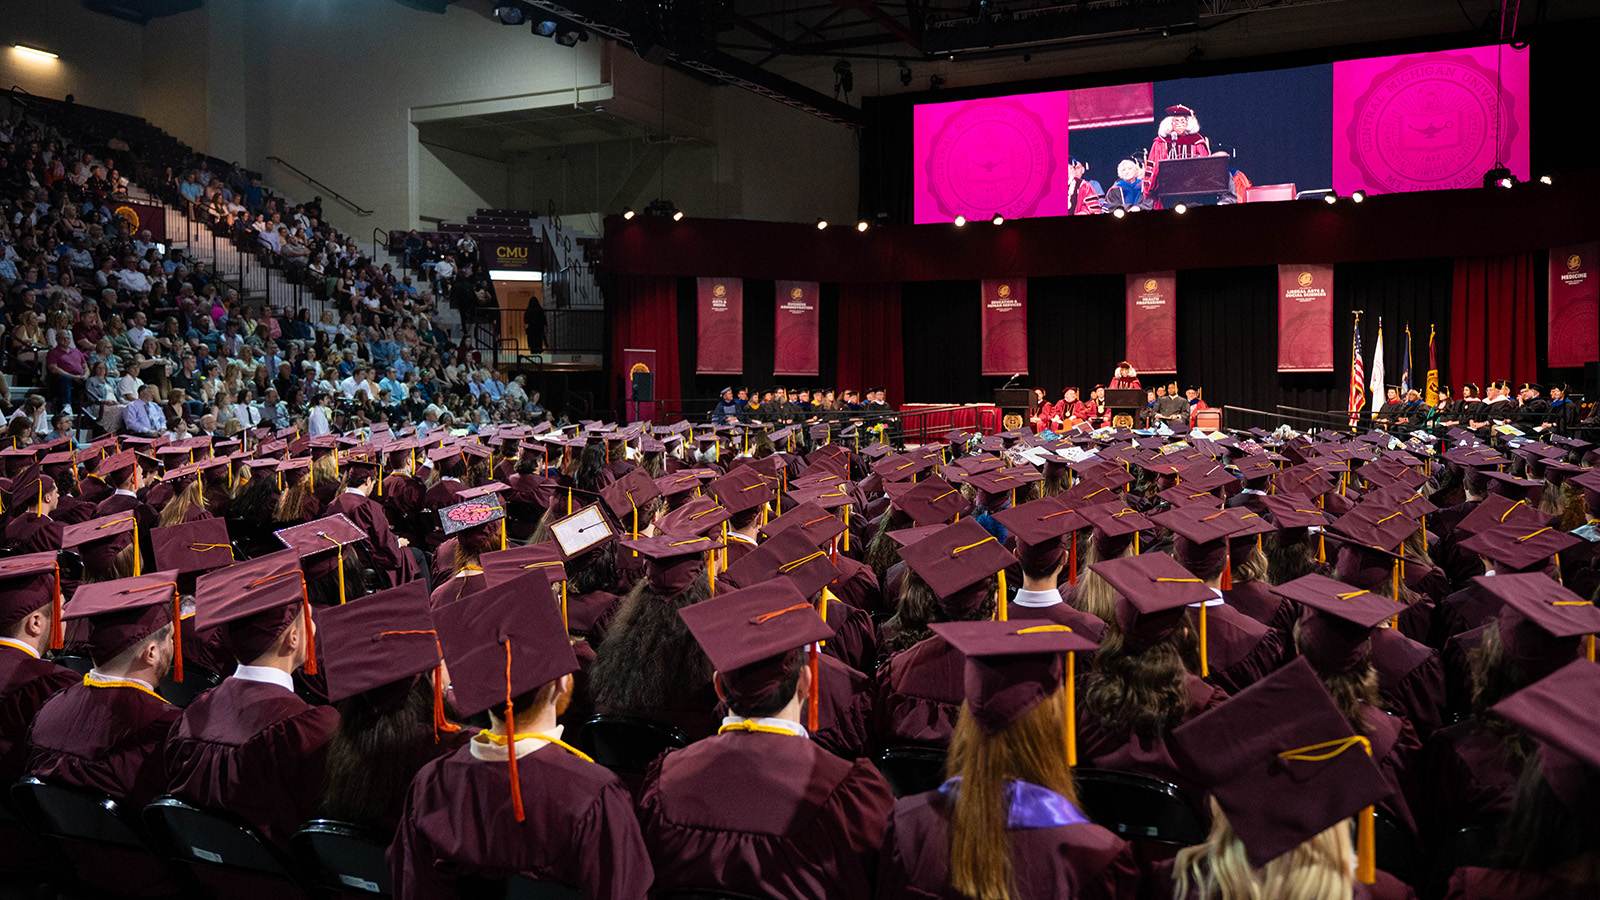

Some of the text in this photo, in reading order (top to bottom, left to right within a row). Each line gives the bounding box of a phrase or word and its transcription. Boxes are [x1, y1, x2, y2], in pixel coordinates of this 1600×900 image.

[1362, 95, 1385, 153] CENTRAL
[1385, 66, 1457, 93] MICHIGAN
[954, 108, 1010, 132] MICHIGAN
[496, 246, 528, 258] CMU
[1561, 272, 1587, 280] MEDICINE
